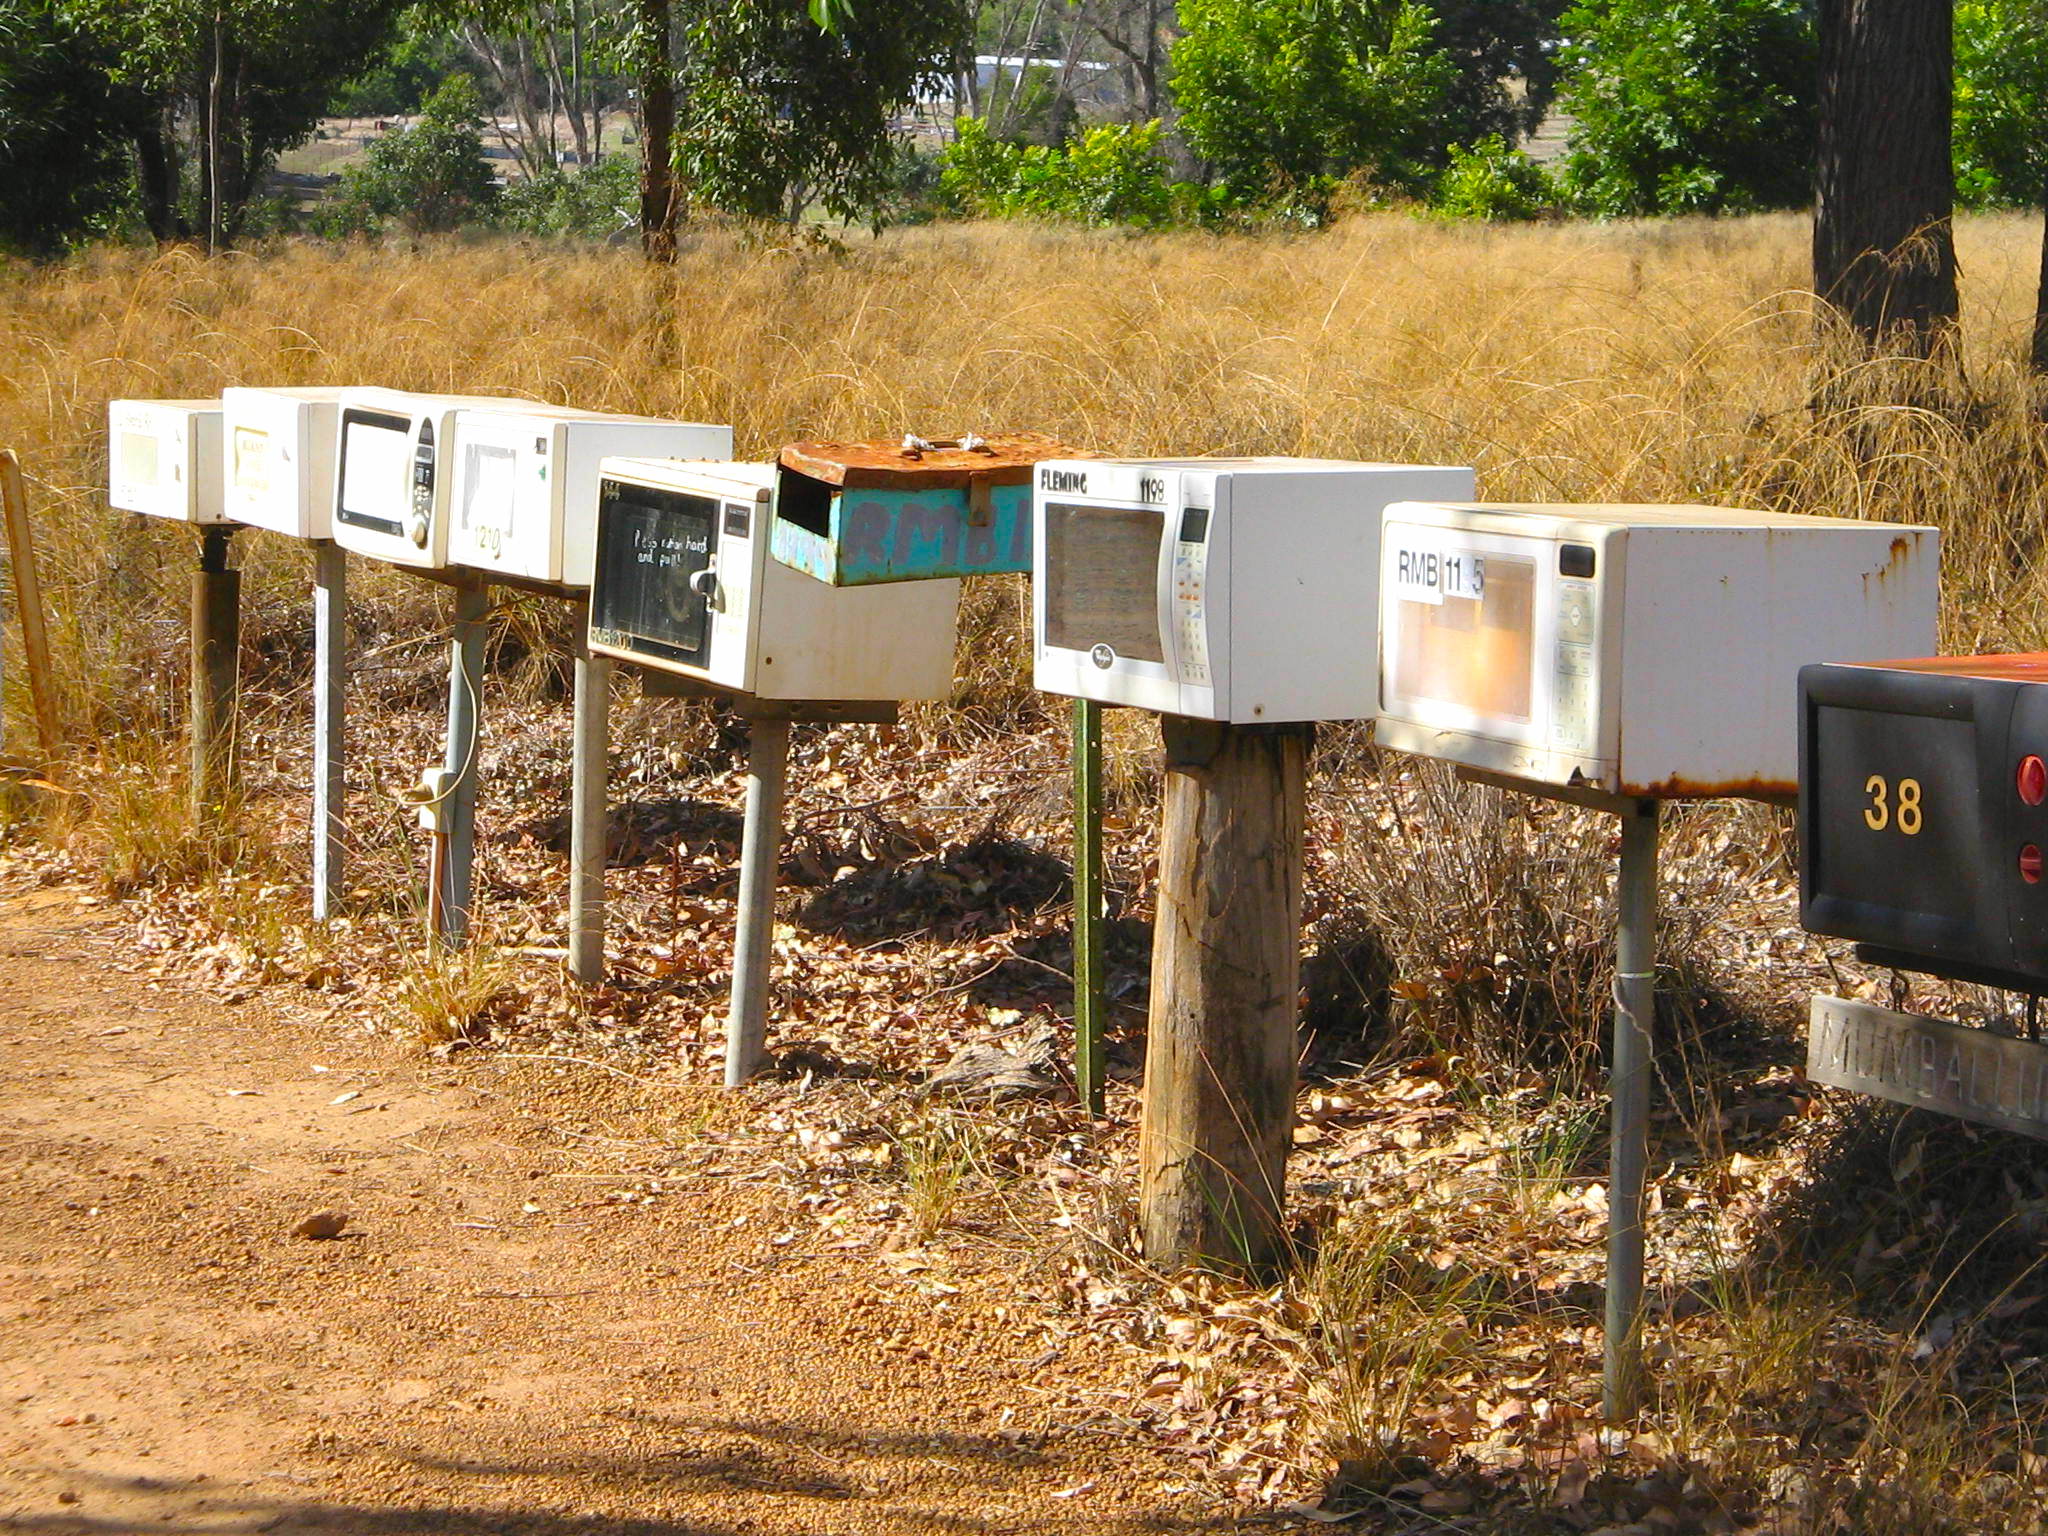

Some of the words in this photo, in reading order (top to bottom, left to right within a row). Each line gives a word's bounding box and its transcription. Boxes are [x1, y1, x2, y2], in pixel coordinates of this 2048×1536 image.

[1041, 468, 1087, 494] FLEMING
[1399, 549, 1438, 587] RMB
[1863, 775, 1924, 836] 38
